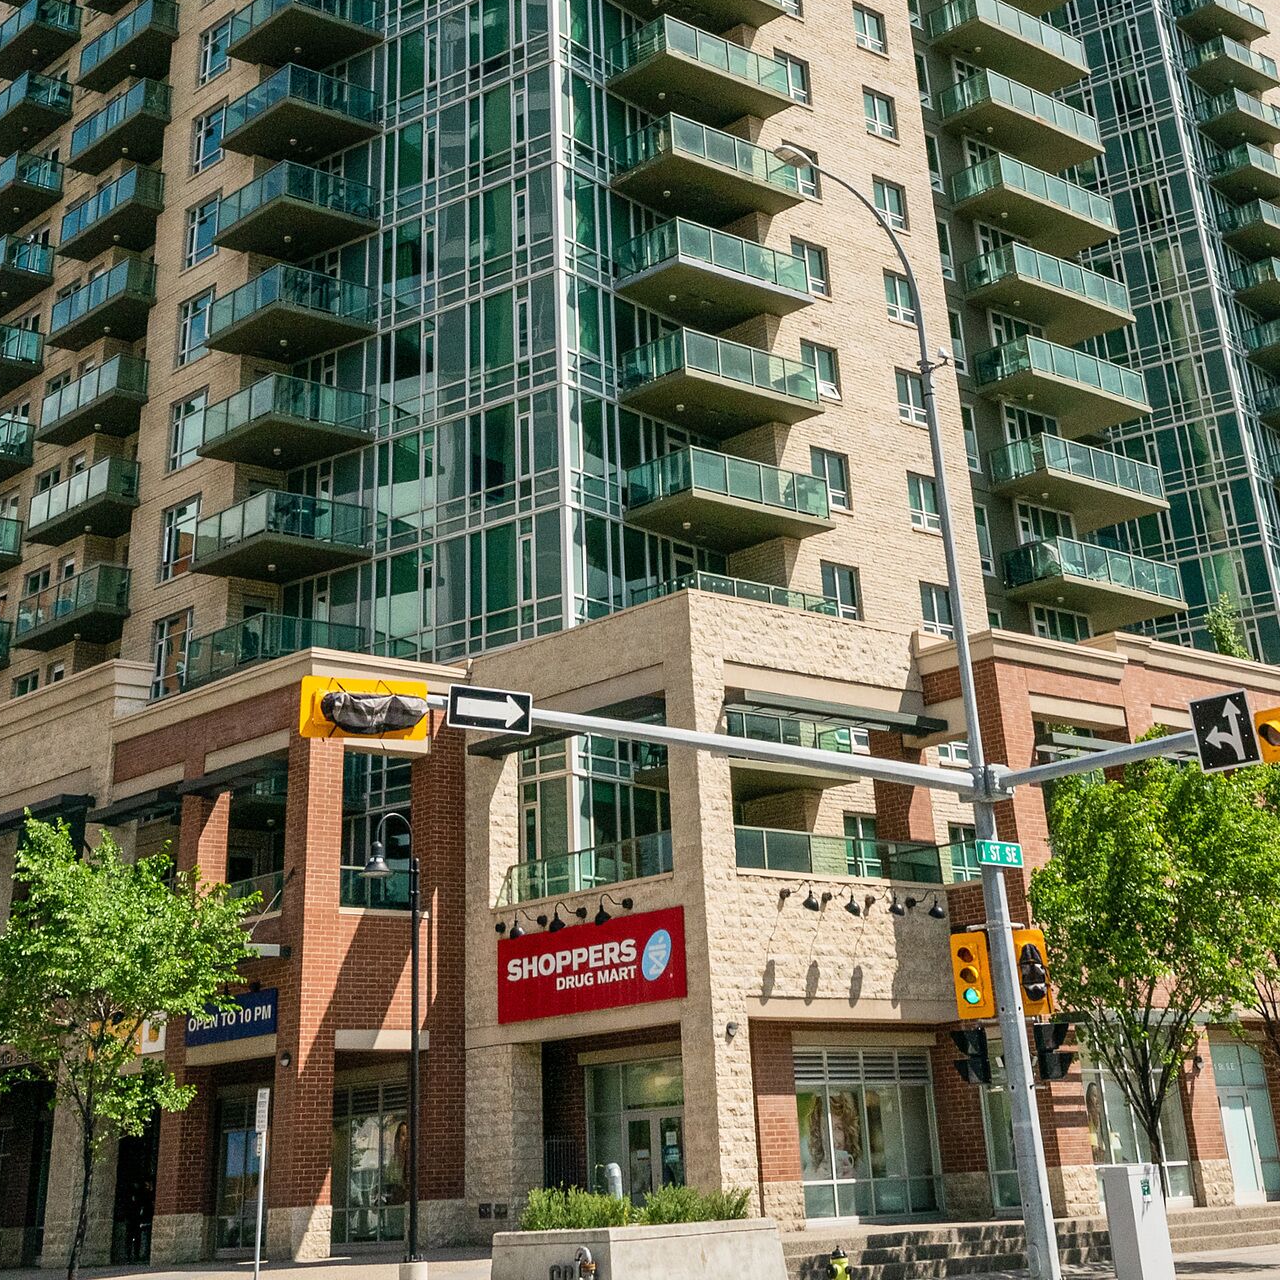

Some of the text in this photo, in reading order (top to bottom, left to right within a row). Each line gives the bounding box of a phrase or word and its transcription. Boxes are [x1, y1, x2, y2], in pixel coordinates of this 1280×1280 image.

[981, 844, 1018, 863] 1 ST SE
[507, 938, 637, 981] SHOPPERS
[556, 966, 637, 990] DRUG MART
[188, 1004, 272, 1032] OPEN TO 10 PM
